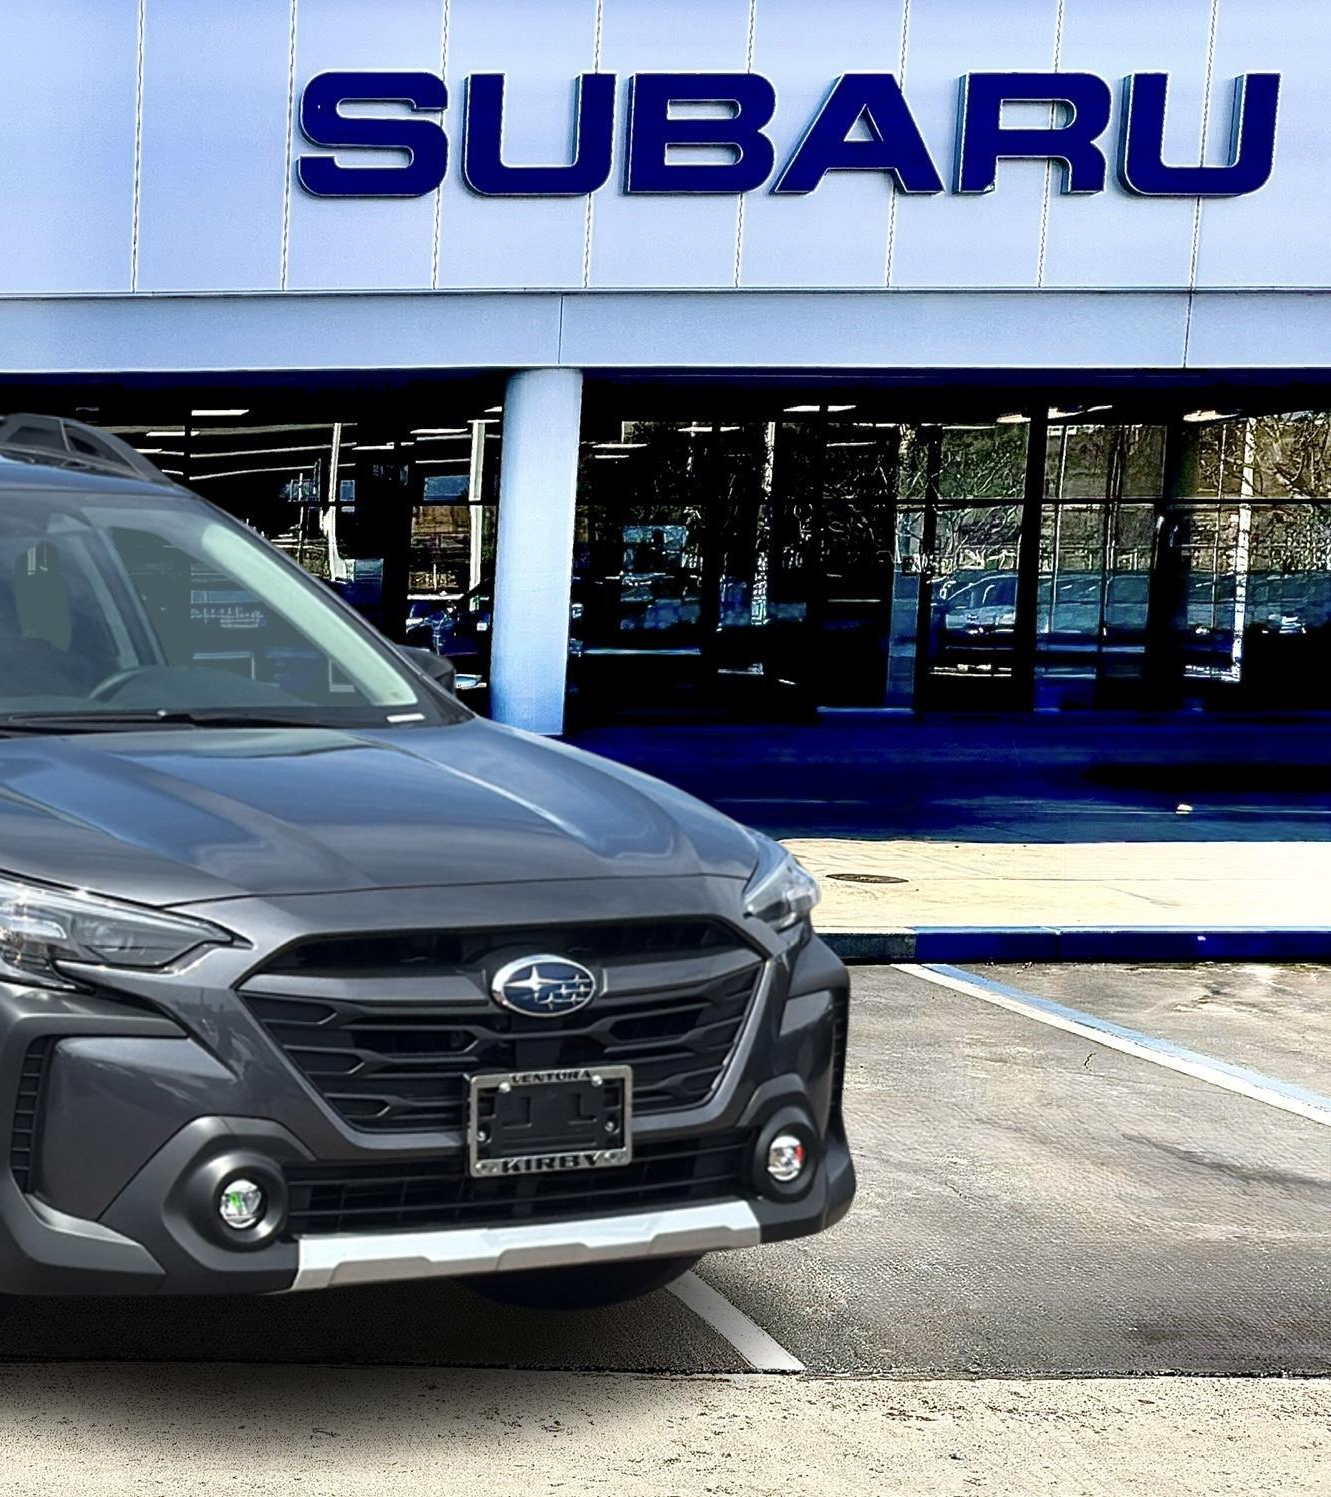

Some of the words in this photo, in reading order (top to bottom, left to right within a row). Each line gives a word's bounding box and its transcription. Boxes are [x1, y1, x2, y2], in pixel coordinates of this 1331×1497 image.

[296, 71, 1281, 198] SUBARU
[511, 1069, 591, 1084] VENTURA
[502, 1152, 599, 1173] KIRBY
